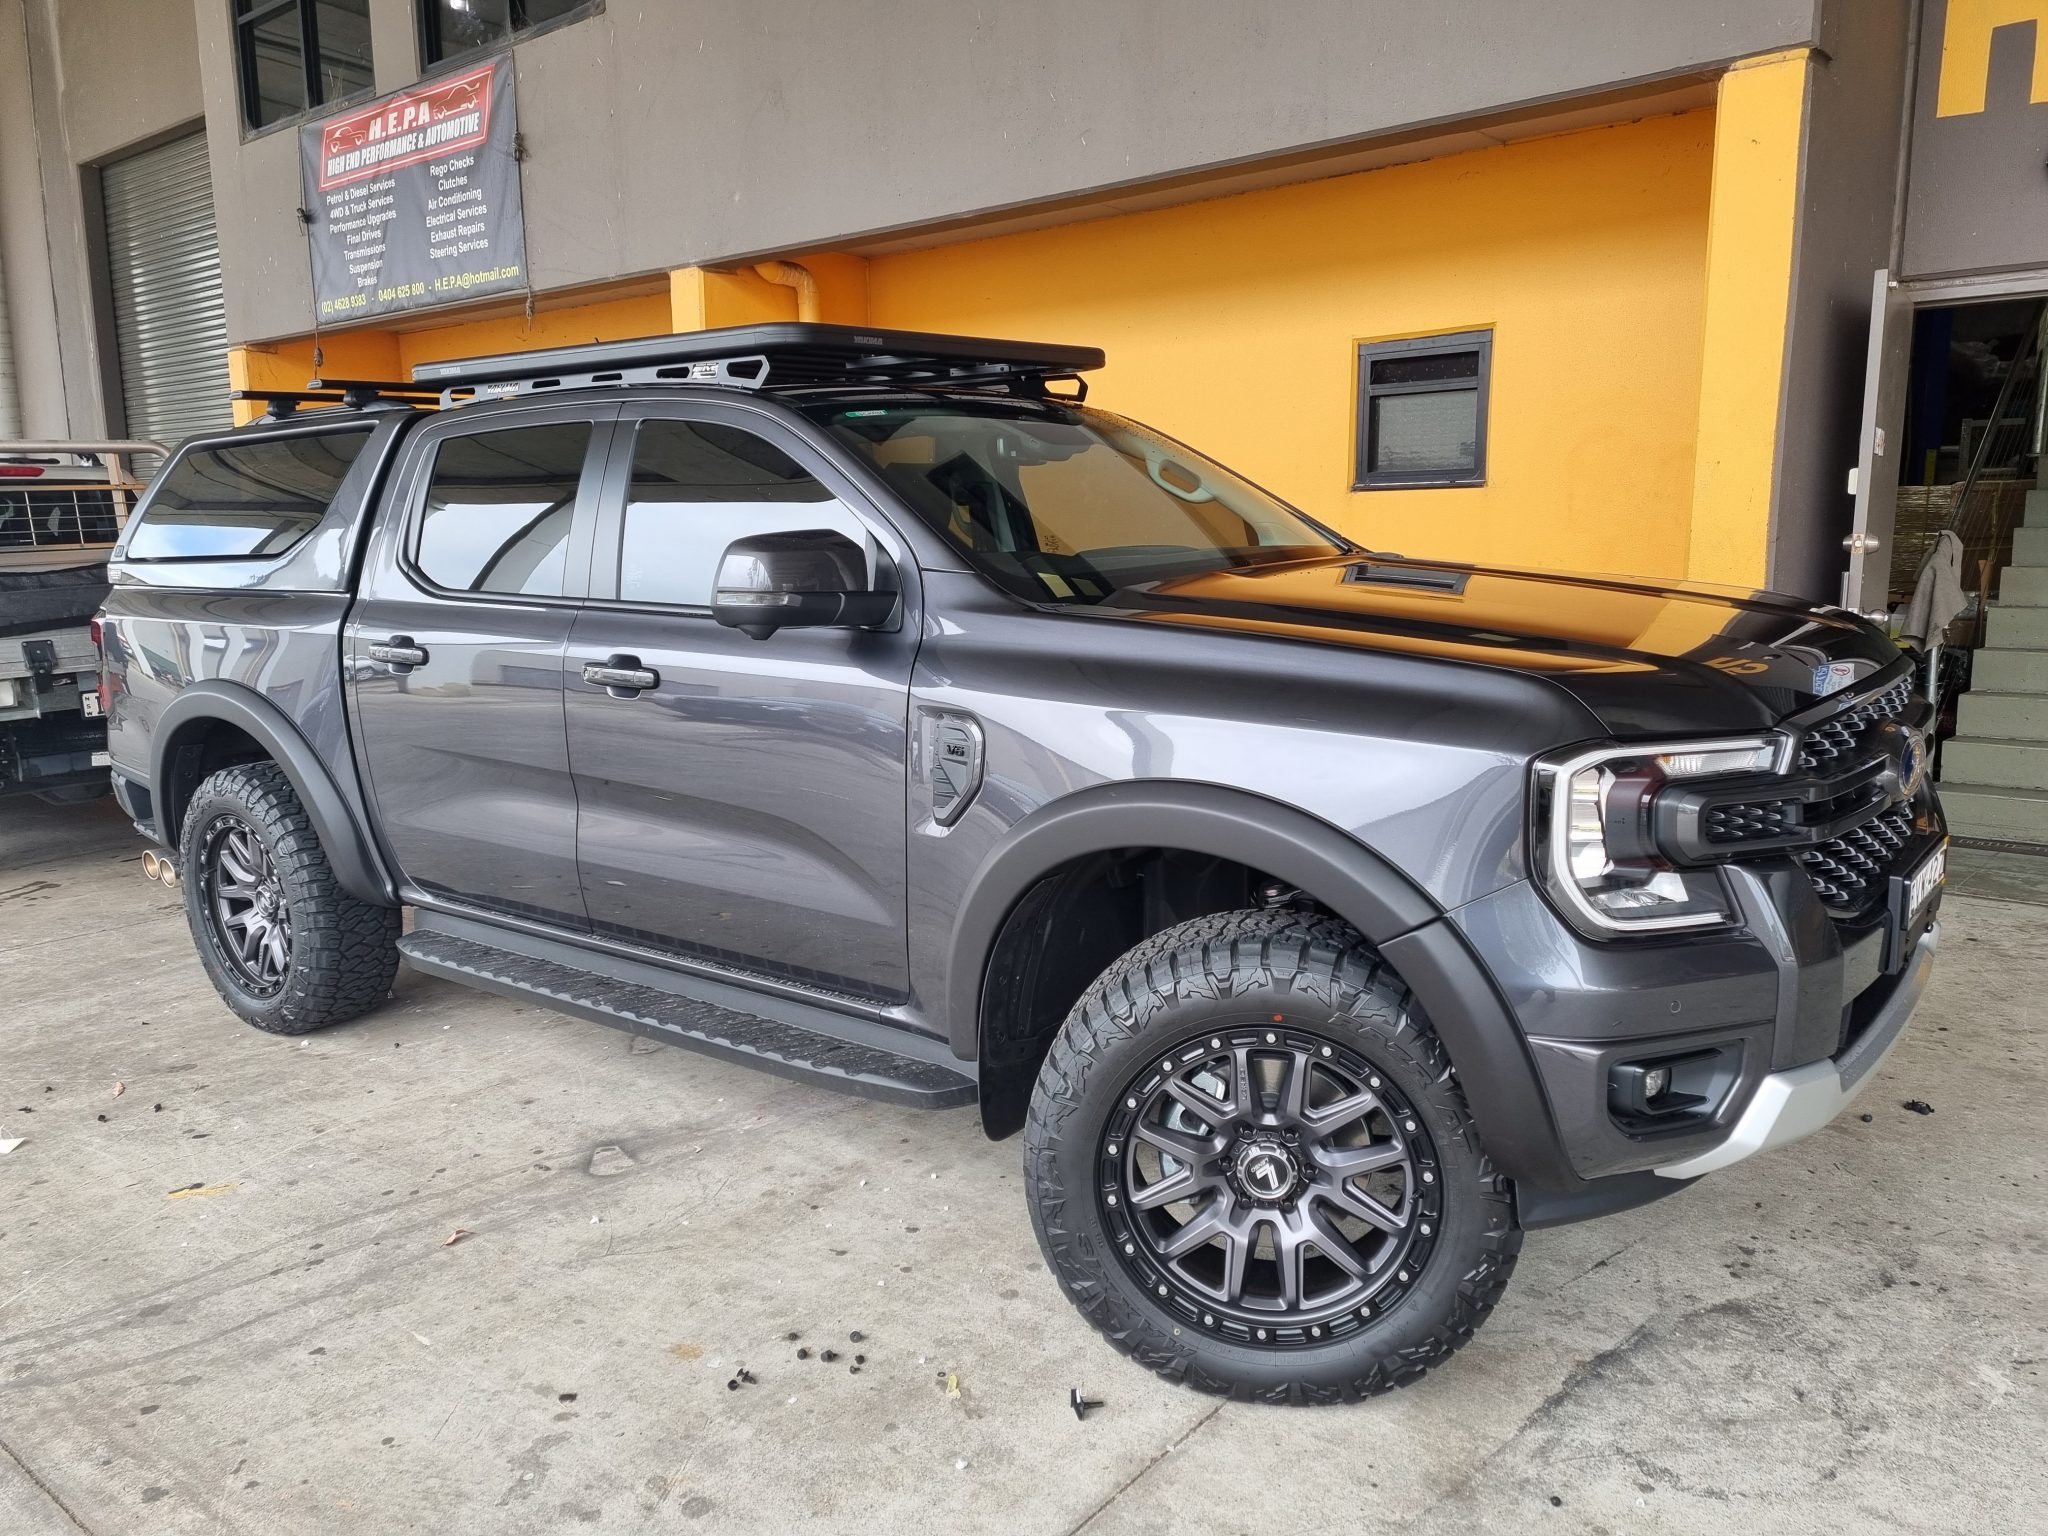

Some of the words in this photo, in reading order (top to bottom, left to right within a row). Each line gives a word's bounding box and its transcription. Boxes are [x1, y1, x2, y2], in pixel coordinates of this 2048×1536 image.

[368, 101, 431, 141] H.E.P.A
[327, 154, 345, 177] HIGH
[346, 149, 360, 170] END
[361, 133, 417, 166] PERFORMANCE
[418, 131, 425, 148] &
[425, 111, 480, 146] AUTOMOTIVE
[430, 164, 448, 177] Rego
[449, 155, 474, 171] Checks
[326, 191, 343, 206] Petrol
[344, 190, 350, 201] &
[350, 185, 369, 200] Diesel
[369, 178, 396, 193] Services
[438, 175, 468, 191] Clutches
[330, 207, 344, 220] 4WD
[345, 205, 350, 216] &
[350, 201, 367, 214] Truck
[368, 194, 394, 209] Services
[428, 198, 437, 212] Air
[438, 188, 482, 208] Conditioning
[329, 218, 366, 234] Performance
[367, 209, 397, 227] Upgrades
[426, 212, 456, 228] Electrical
[457, 204, 487, 220] Services
[346, 233, 361, 246] Final
[361, 229, 382, 242] Drives
[430, 228, 457, 243] Exhaust
[458, 221, 485, 237] Repairs
[343, 243, 386, 261] Transmissions
[430, 245, 457, 259] Steering
[458, 238, 489, 253] Services
[349, 259, 383, 275] Suspension
[357, 275, 378, 288] Brakes
[321, 299, 333, 316] (02)
[378, 287, 396, 302] 0404
[397, 284, 410, 298] 625
[411, 281, 425, 296] 800
